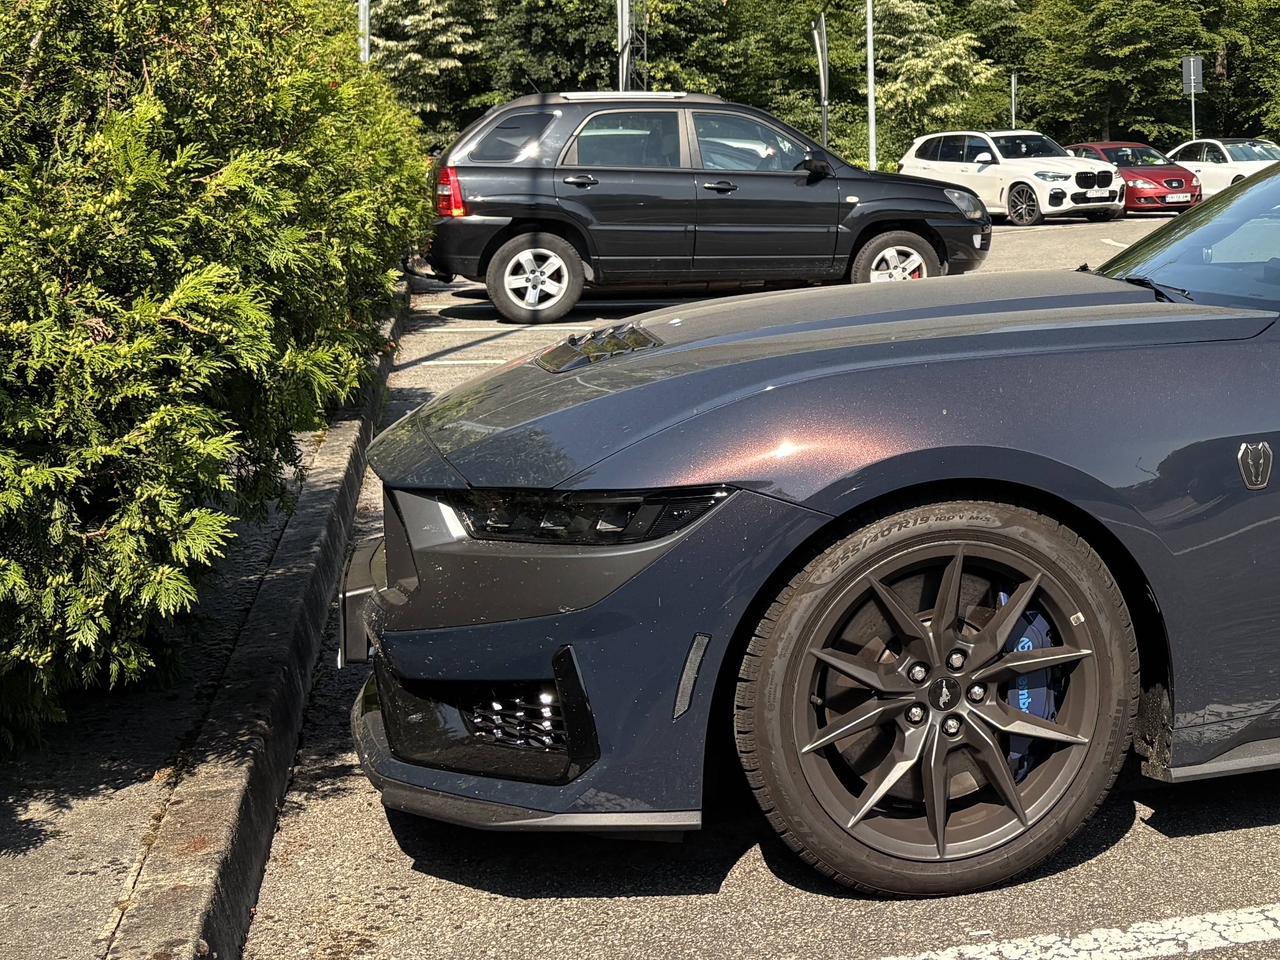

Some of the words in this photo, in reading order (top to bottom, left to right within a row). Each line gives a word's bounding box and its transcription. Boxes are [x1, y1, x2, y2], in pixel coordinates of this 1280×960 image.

[830, 526, 893, 573] 255/40
[897, 515, 930, 531] R19
[1102, 698, 1129, 768] PIRELLI
